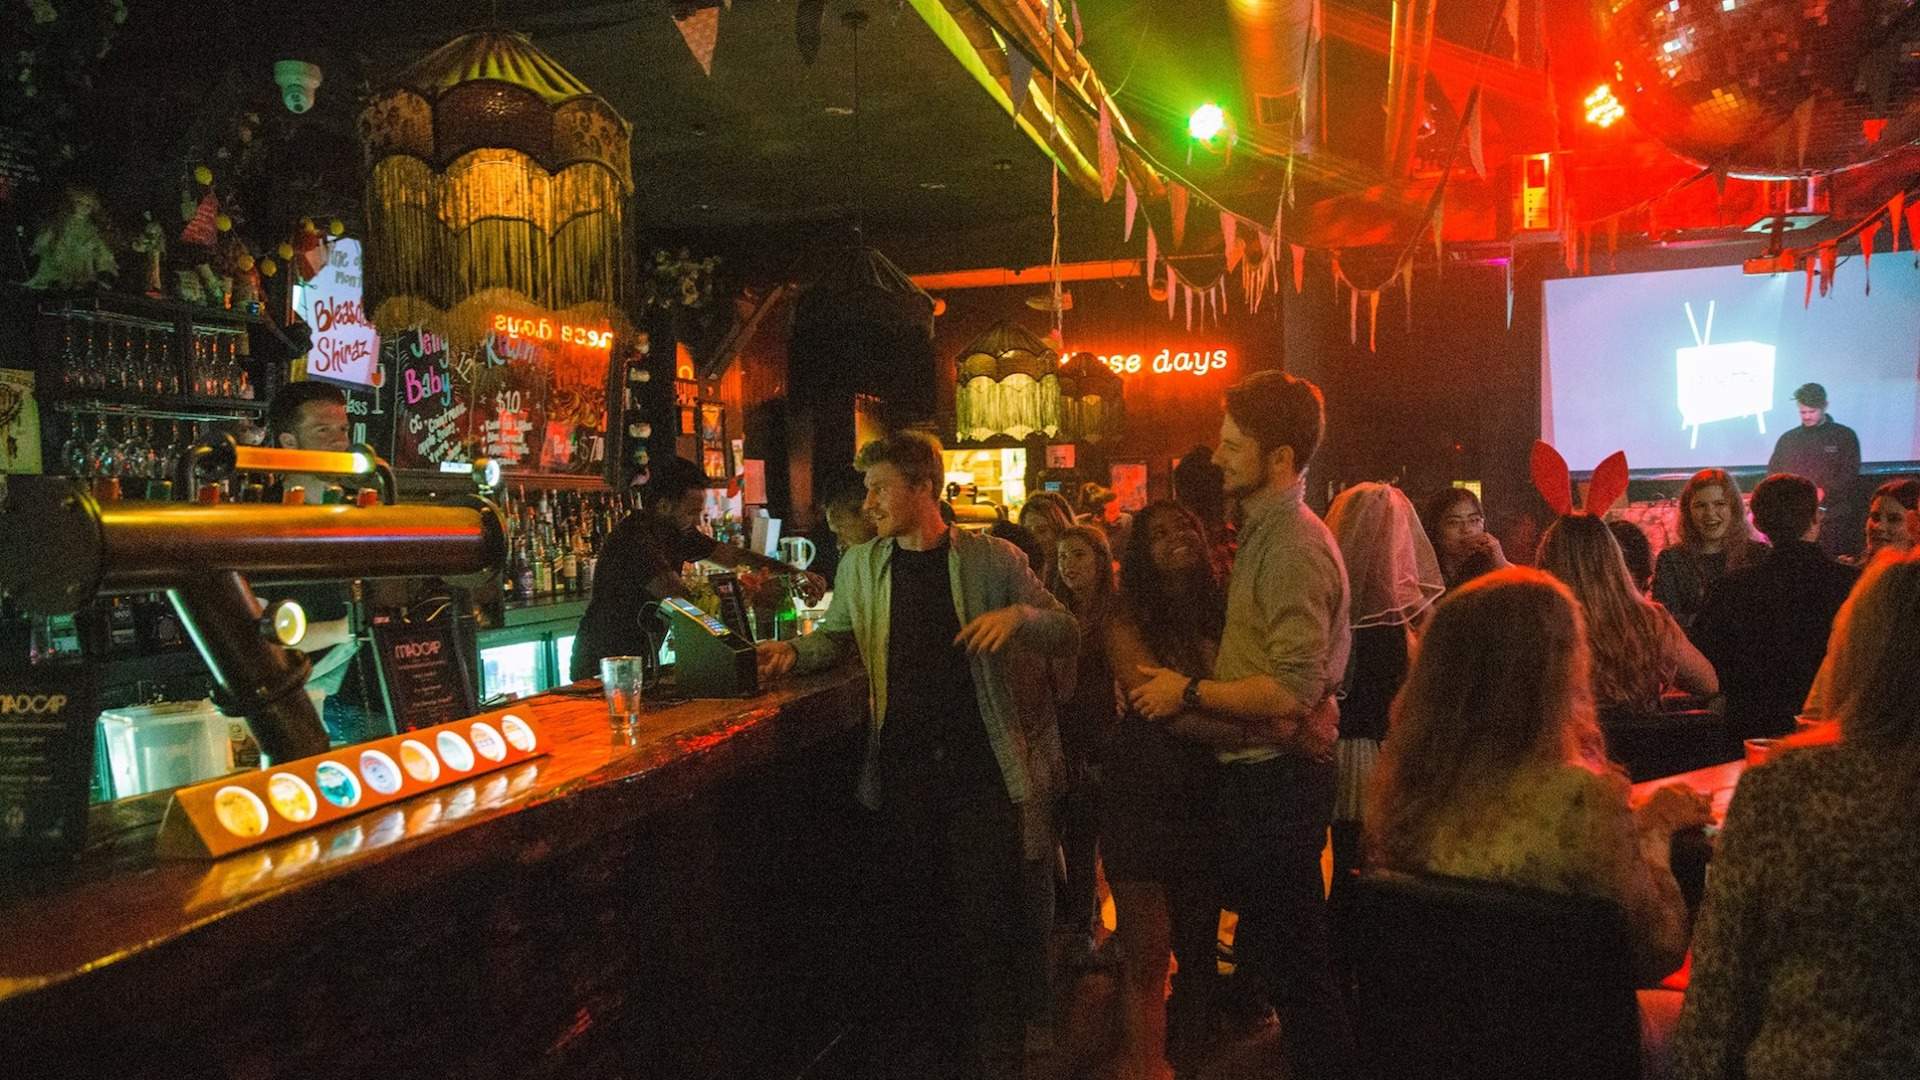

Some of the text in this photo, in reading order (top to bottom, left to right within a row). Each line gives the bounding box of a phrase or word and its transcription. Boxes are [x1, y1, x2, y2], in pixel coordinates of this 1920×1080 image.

[316, 337, 371, 372] Shiraz
[1152, 348, 1228, 376] days
[404, 366, 452, 407] Baby
[341, 389, 368, 415] lass
[495, 390, 521, 414] $10
